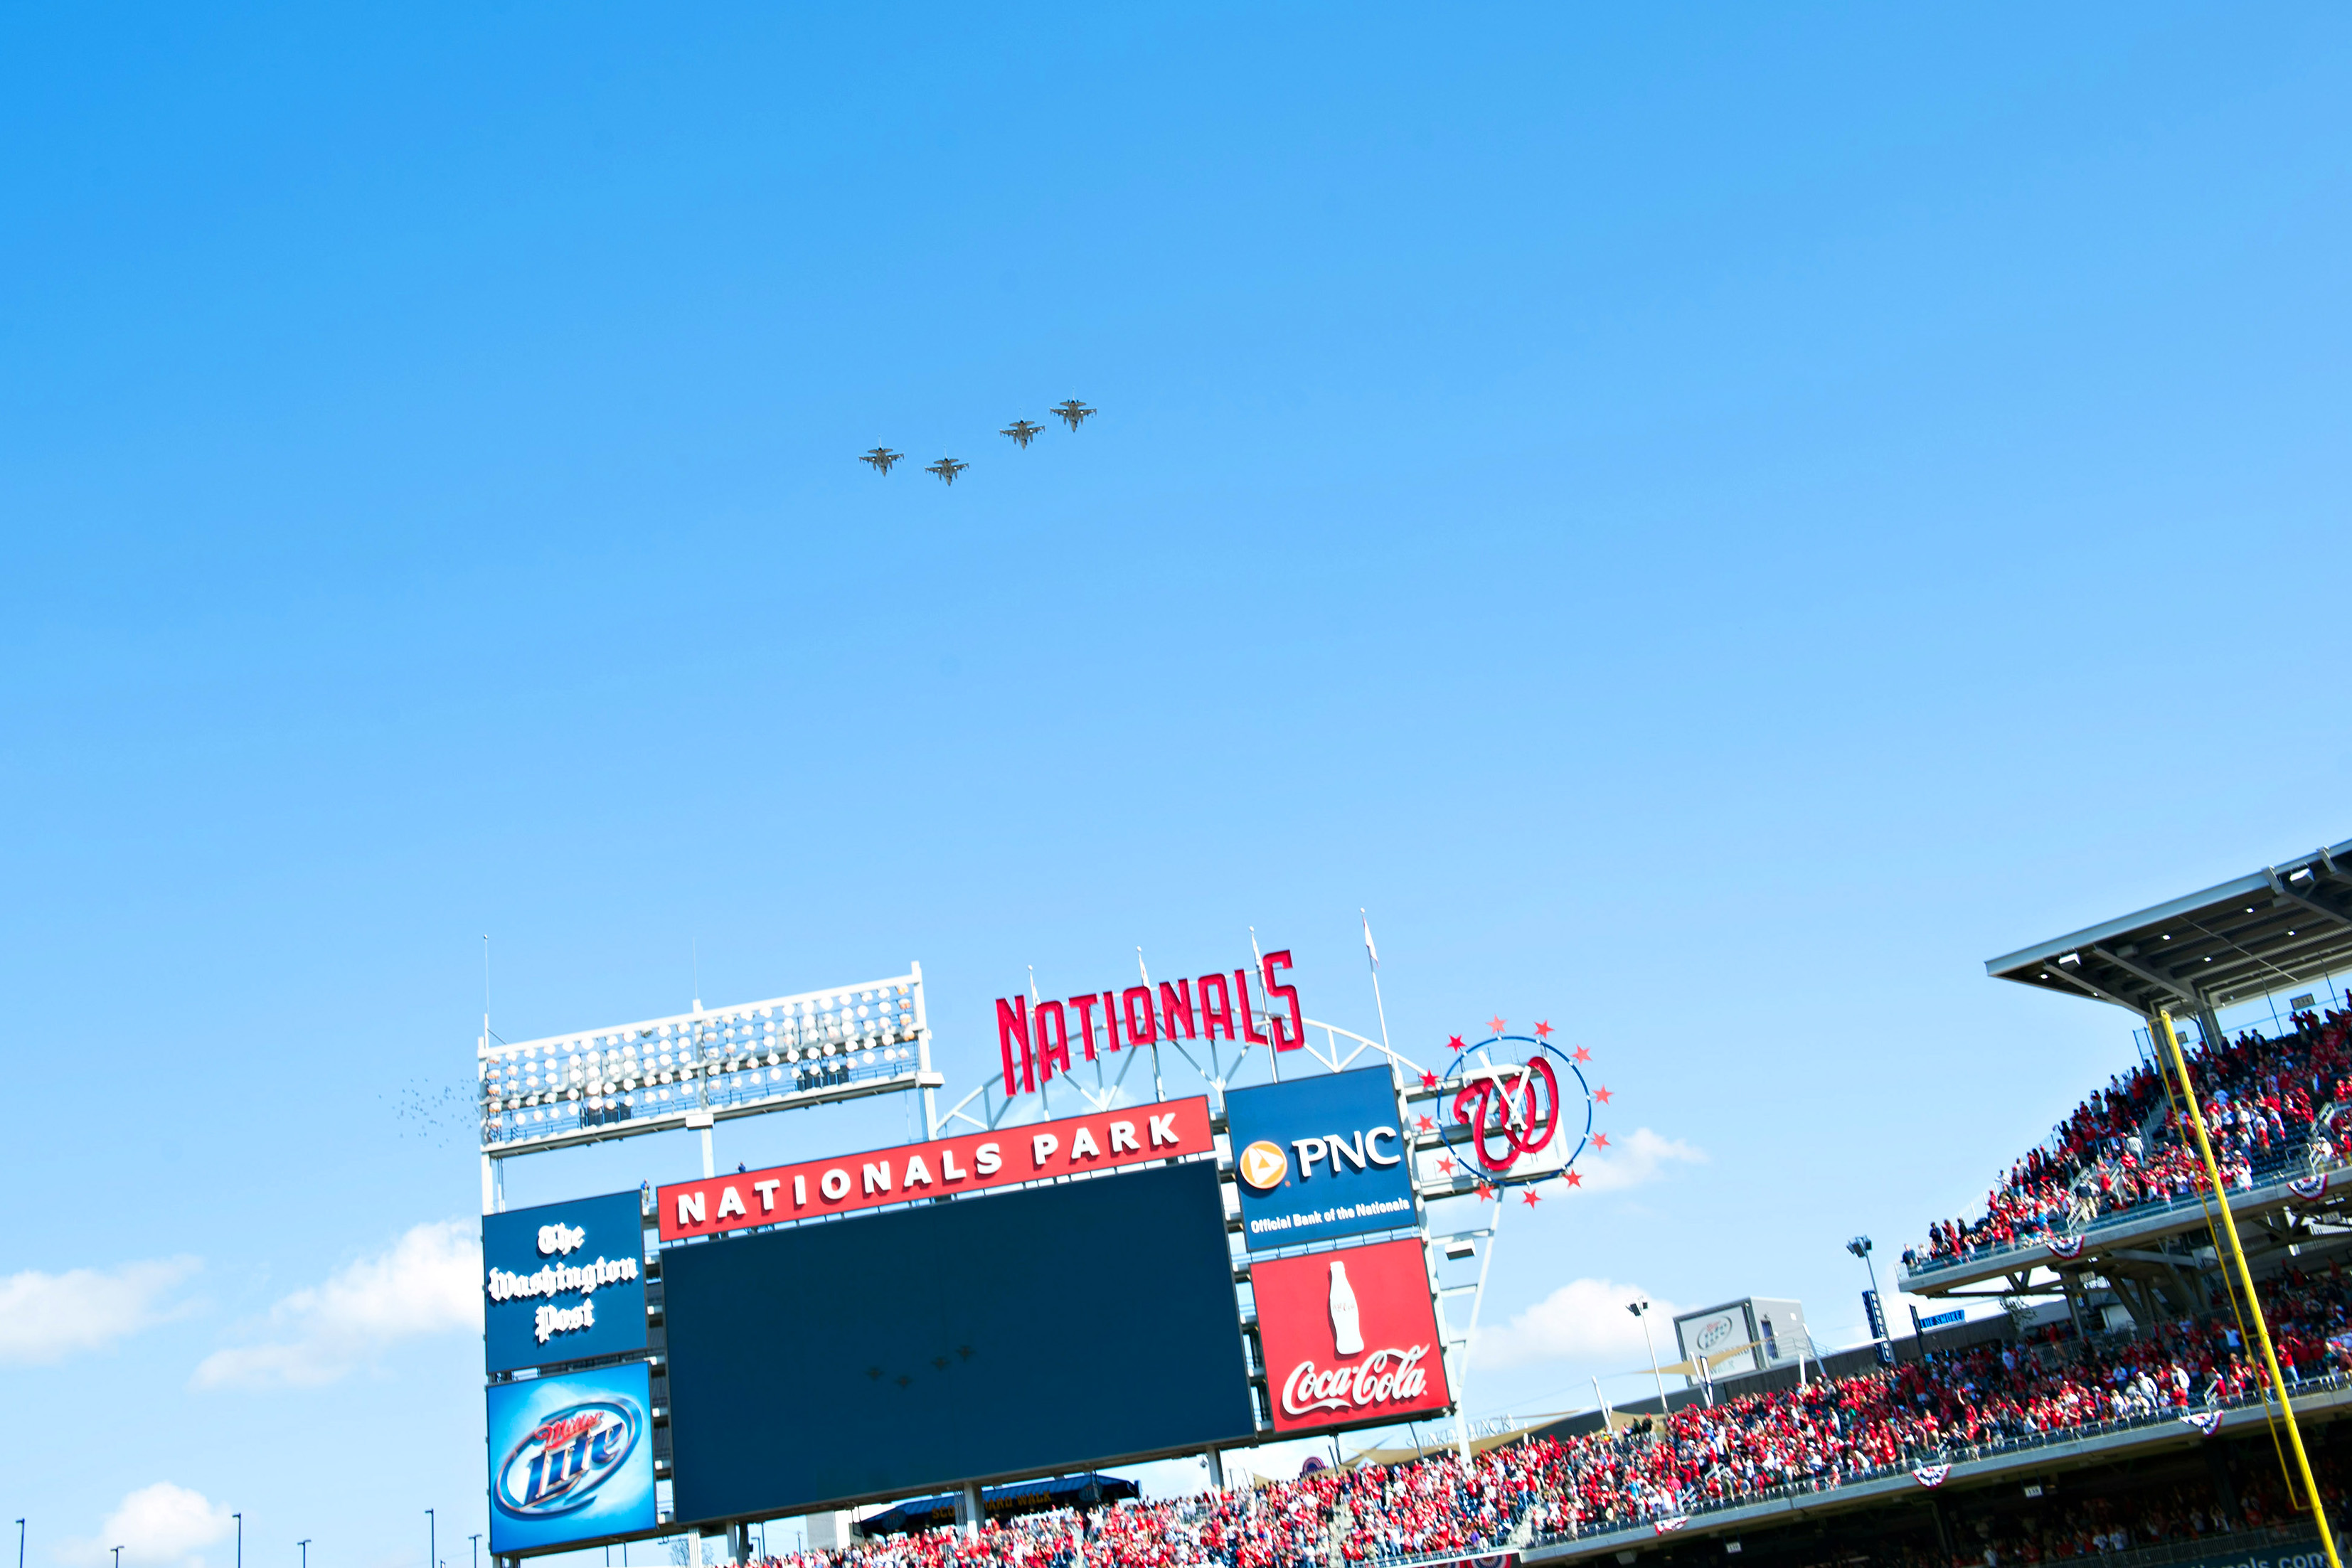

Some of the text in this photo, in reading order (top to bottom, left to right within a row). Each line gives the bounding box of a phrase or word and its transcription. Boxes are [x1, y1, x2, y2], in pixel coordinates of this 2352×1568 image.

[996, 949, 1304, 1098] NATIONALS
[677, 1113, 1180, 1225] NATIONALS PARK
[1292, 1126, 1401, 1177] PNC
[538, 1222, 585, 1255] The
[1250, 1198, 1410, 1234] Official Bank of the Nationals
[488, 1256, 639, 1301] Washington
[535, 1298, 595, 1343] Post
[1282, 1343, 1430, 1415] Coca-Cola
[534, 1411, 605, 1451] Miller
[522, 1422, 624, 1508] Lite
[1017, 1490, 1052, 1506] WALK
